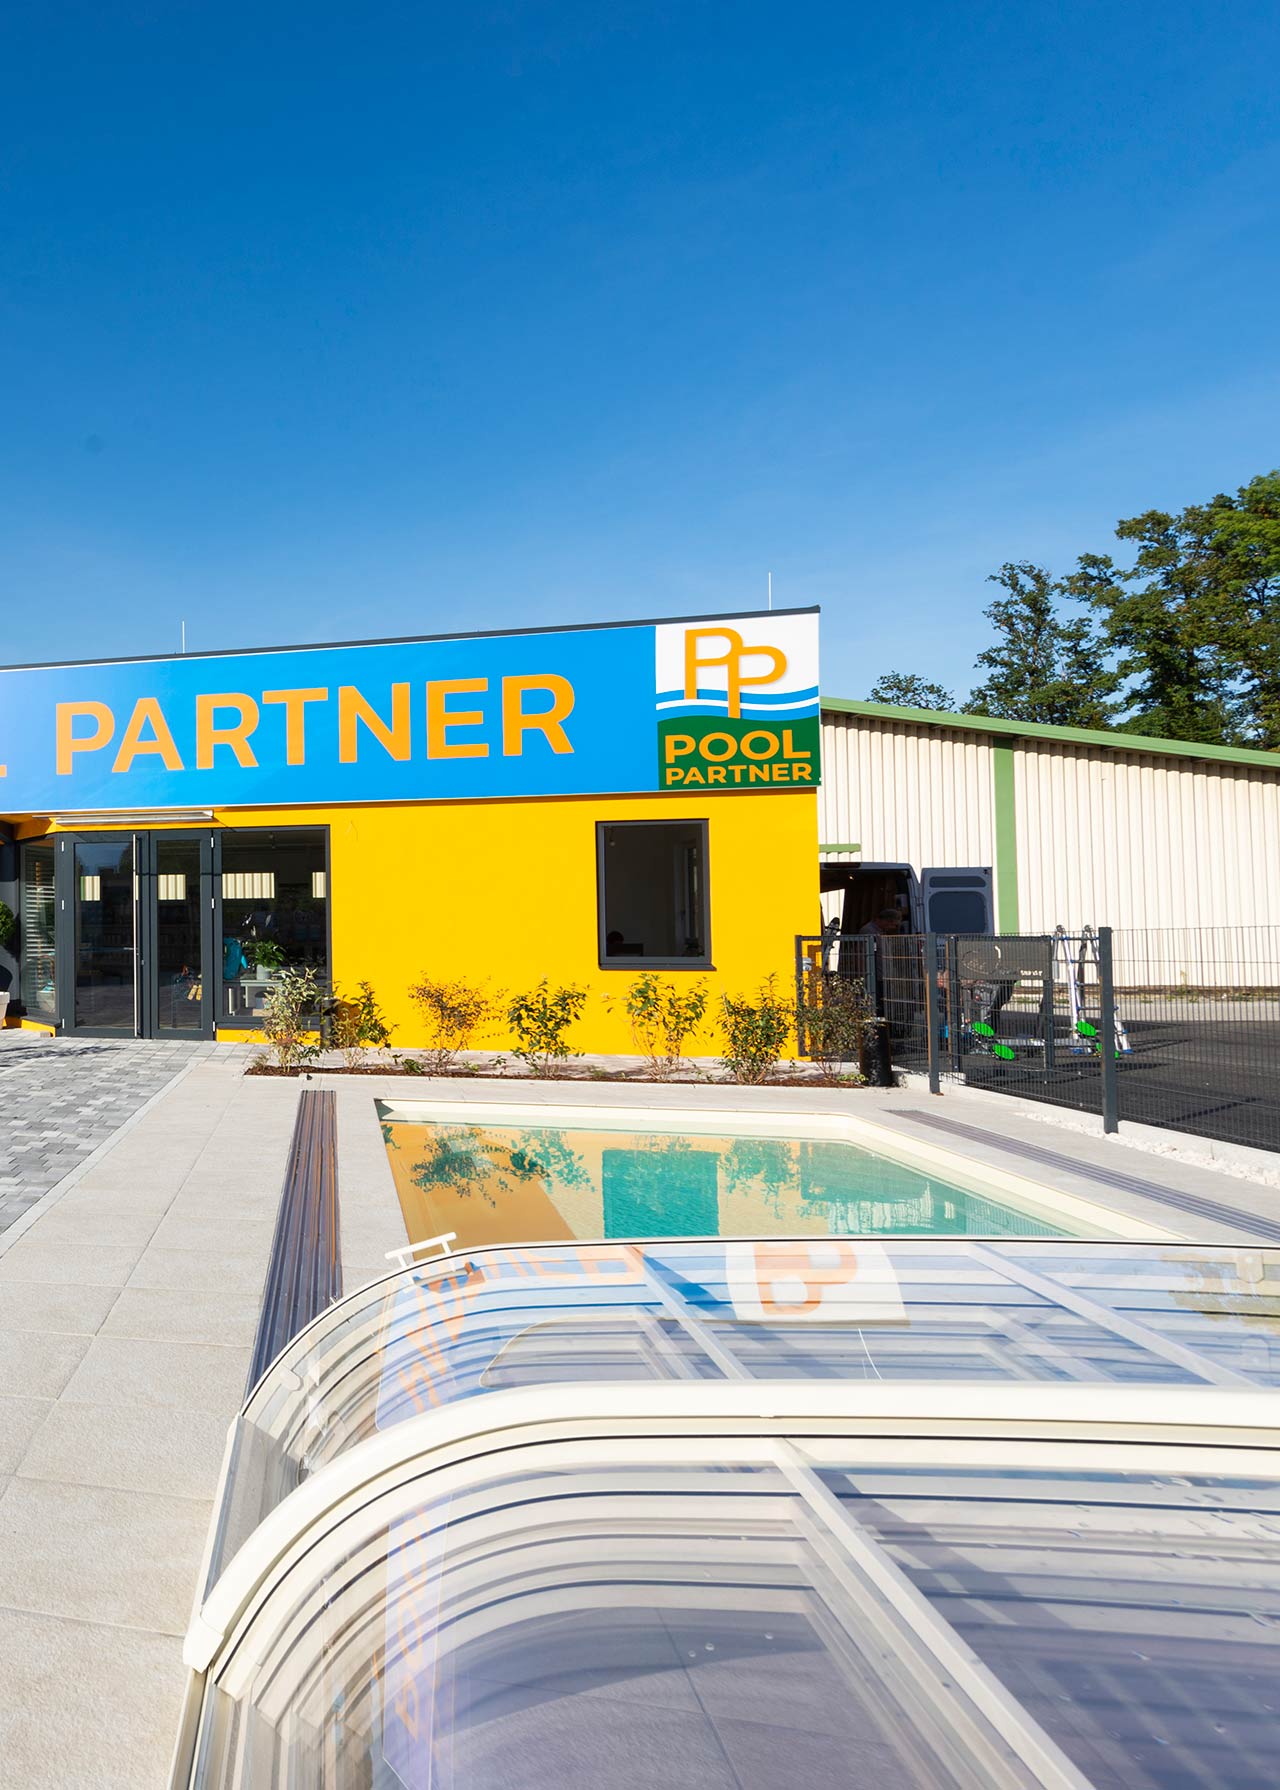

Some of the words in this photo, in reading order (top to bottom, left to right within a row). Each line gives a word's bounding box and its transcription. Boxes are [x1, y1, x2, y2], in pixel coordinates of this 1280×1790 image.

[55, 673, 575, 776] PARTNER
[664, 729, 811, 764] POOL
[665, 763, 813, 785] PARTNER
